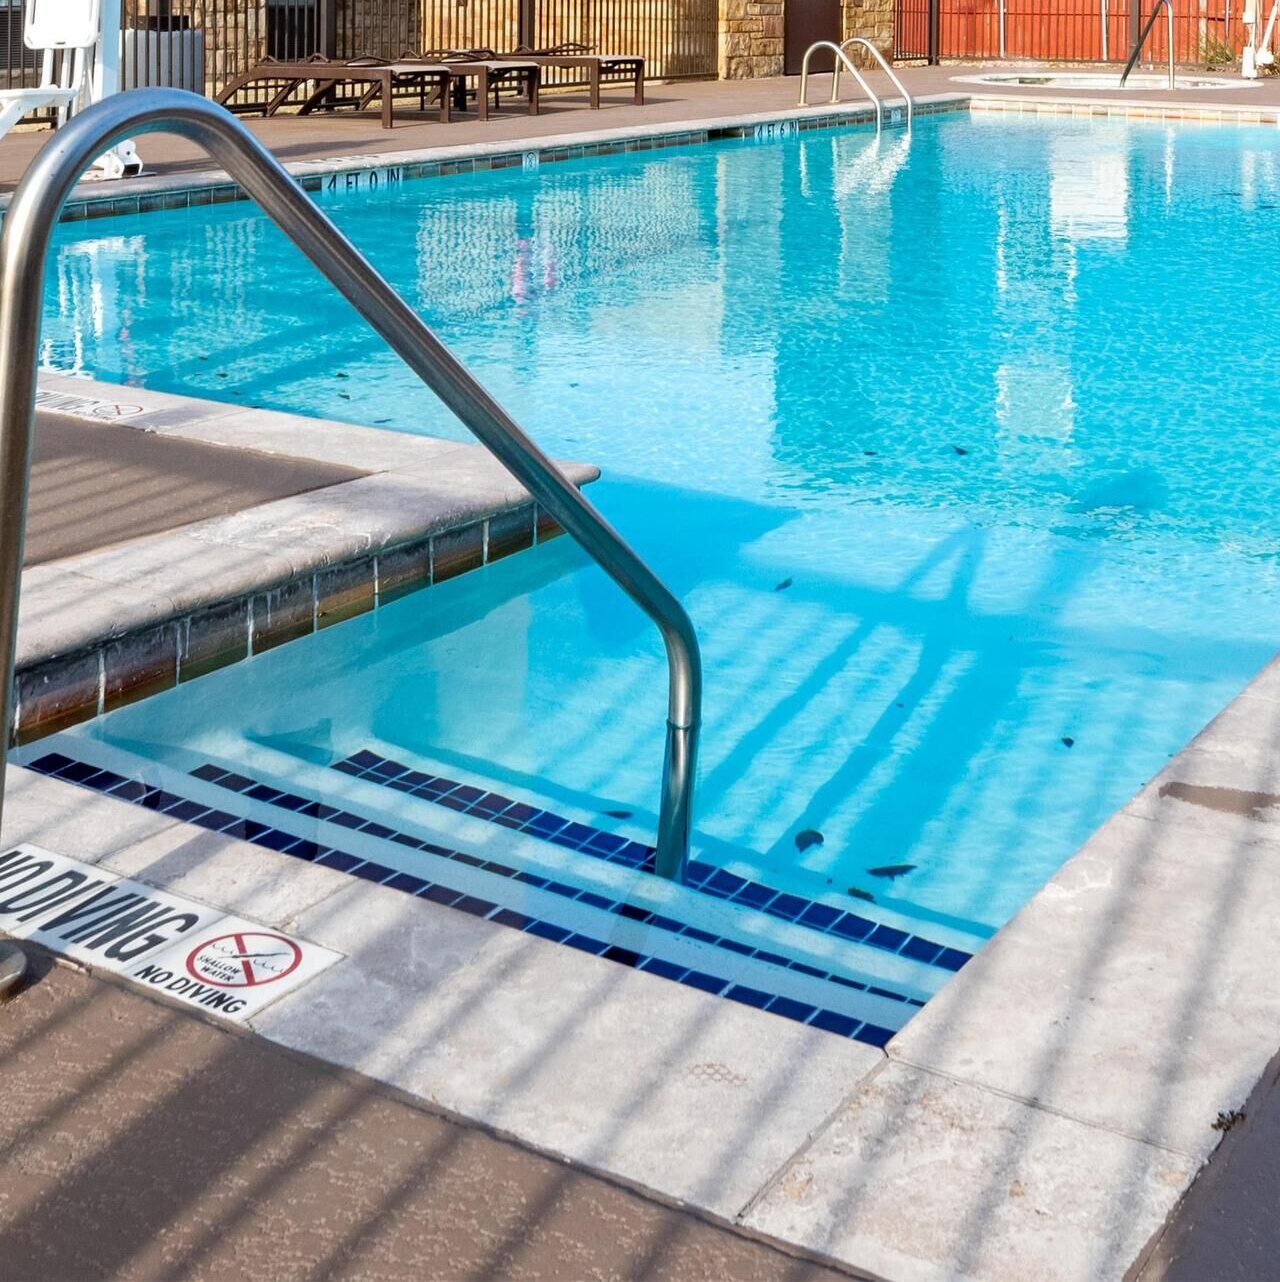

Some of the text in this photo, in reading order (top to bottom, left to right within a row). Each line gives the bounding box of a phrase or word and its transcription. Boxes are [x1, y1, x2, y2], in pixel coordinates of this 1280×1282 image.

[346, 173, 360, 188] FT
[387, 167, 400, 182] IN
[197, 955, 242, 975] SHALLOW
[201, 966, 235, 982] WATER
[134, 964, 247, 1013] NO DIVING
